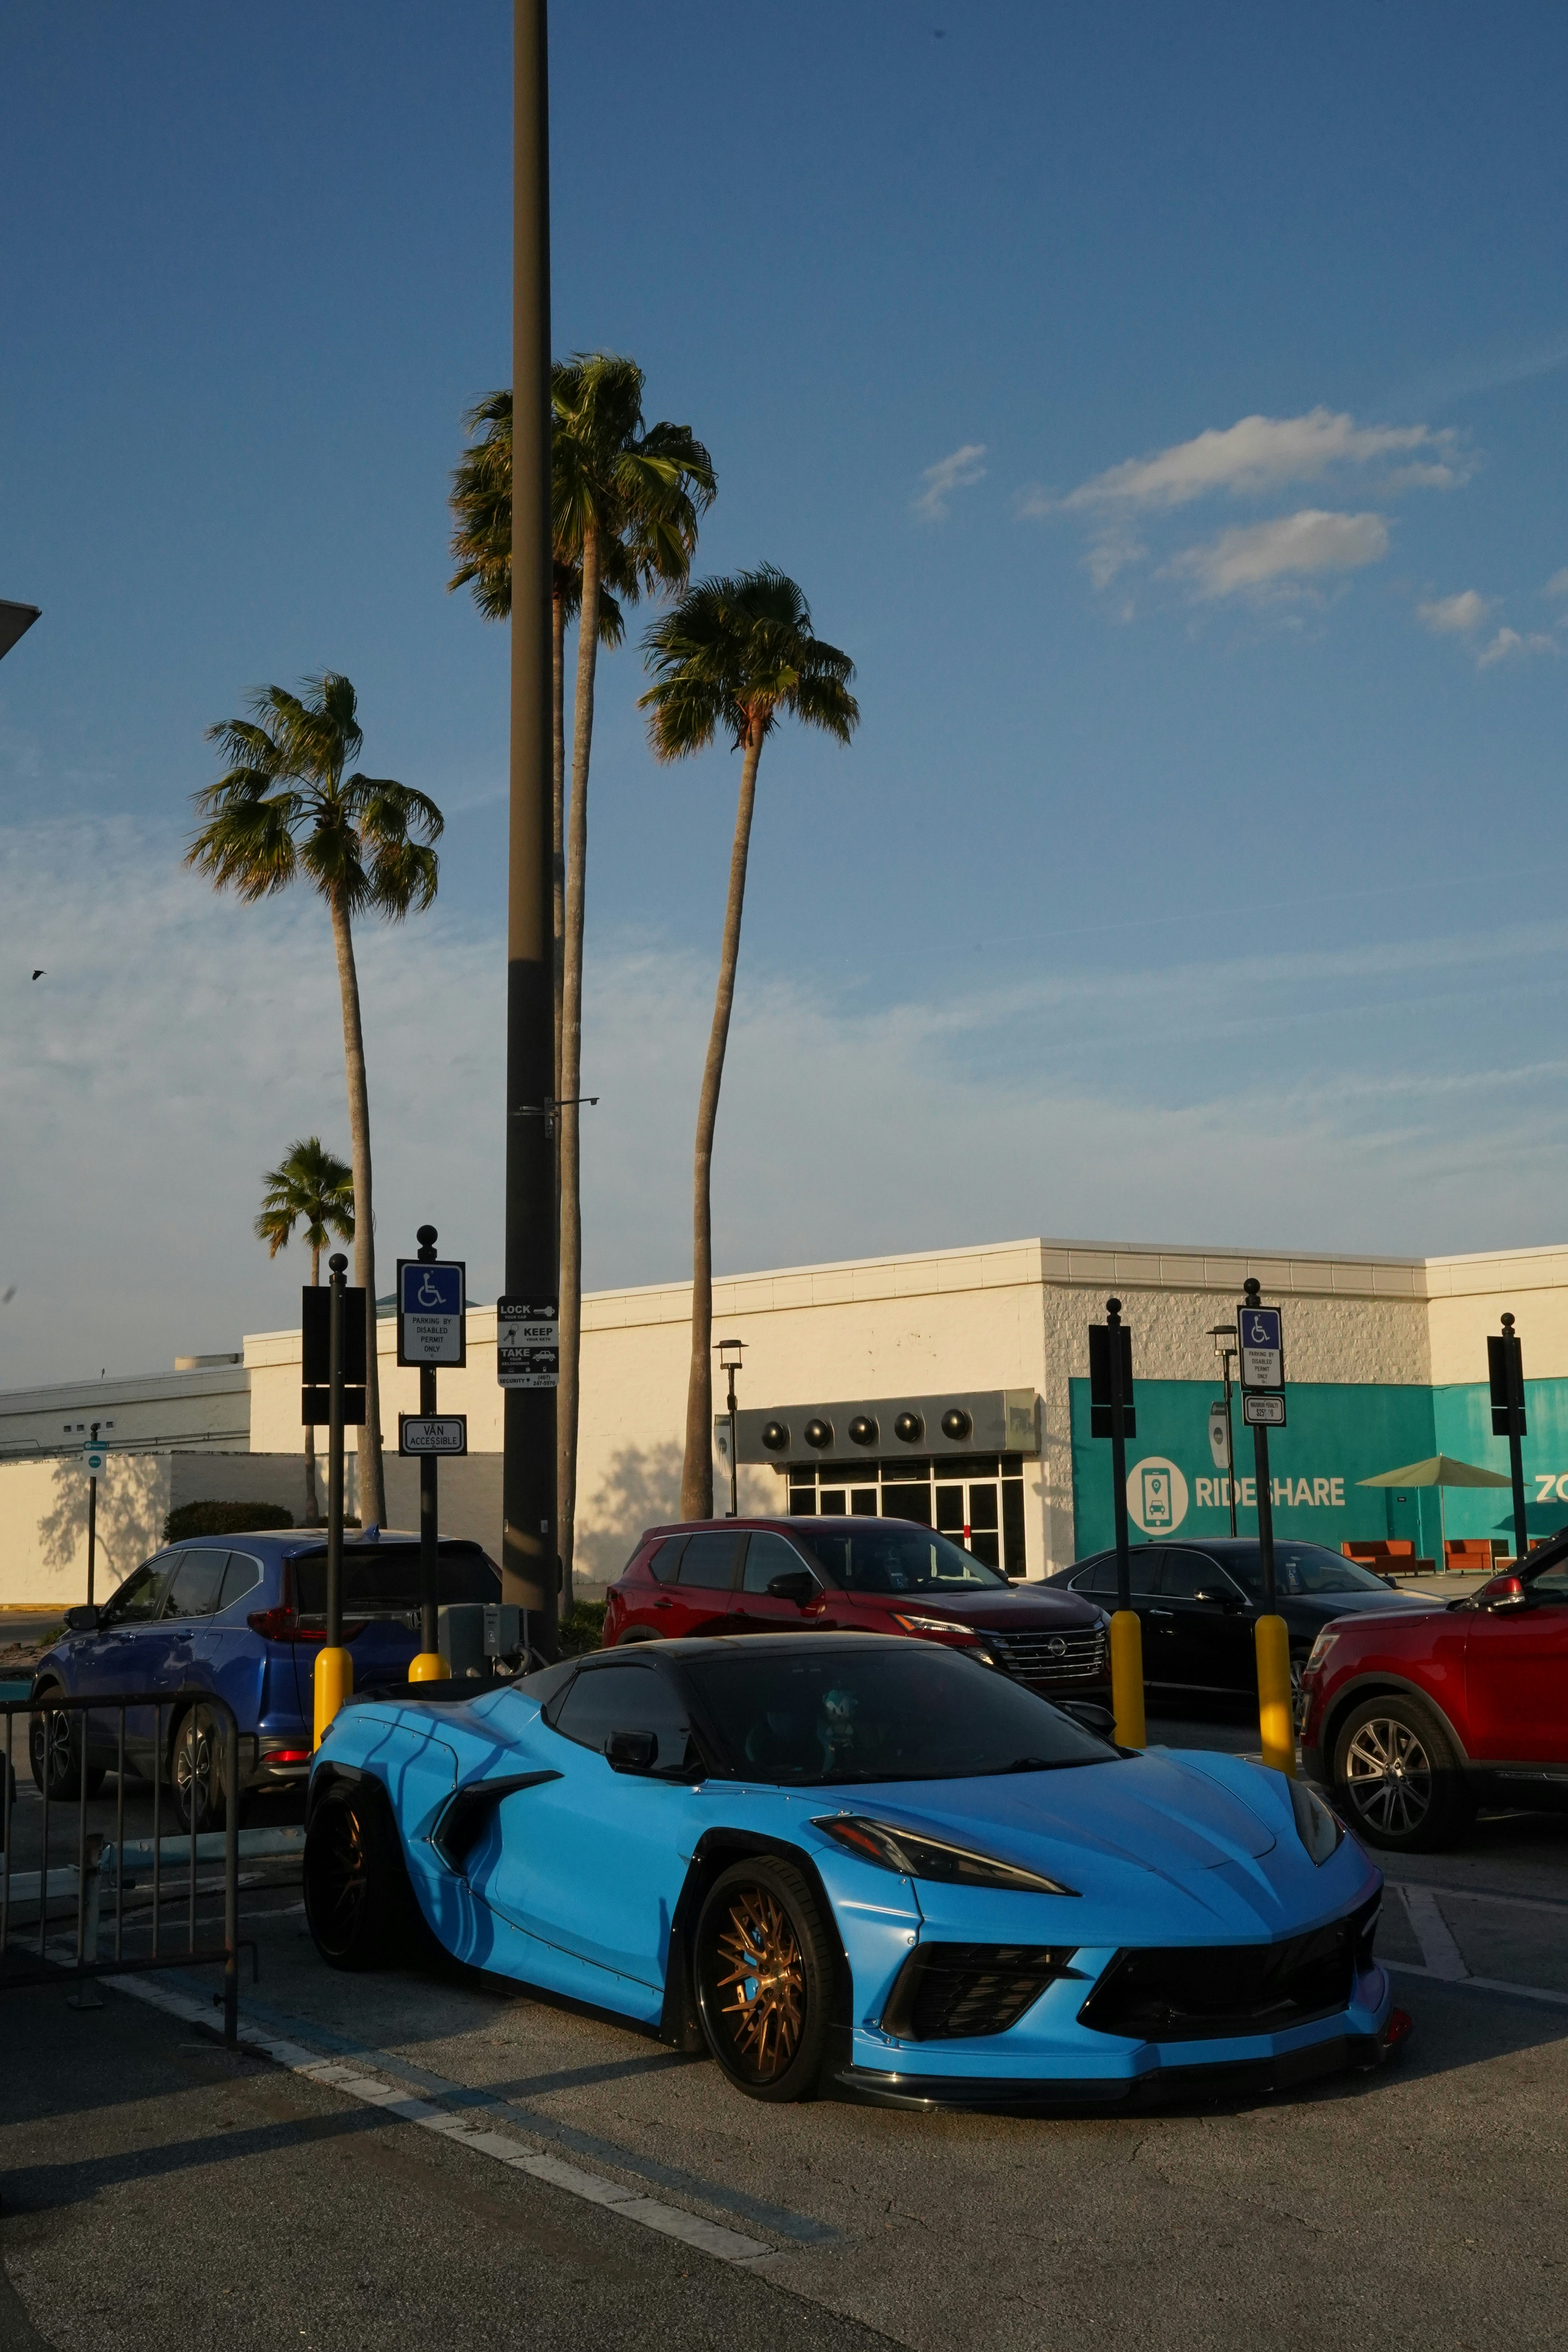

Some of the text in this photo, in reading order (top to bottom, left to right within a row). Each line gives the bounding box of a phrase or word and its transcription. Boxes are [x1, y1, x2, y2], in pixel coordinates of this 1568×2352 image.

[501, 1305, 530, 1314] LOCK
[524, 1328, 553, 1336] KEEP
[501, 1348, 530, 1357] TAKE
[424, 1426, 443, 1436] VAN
